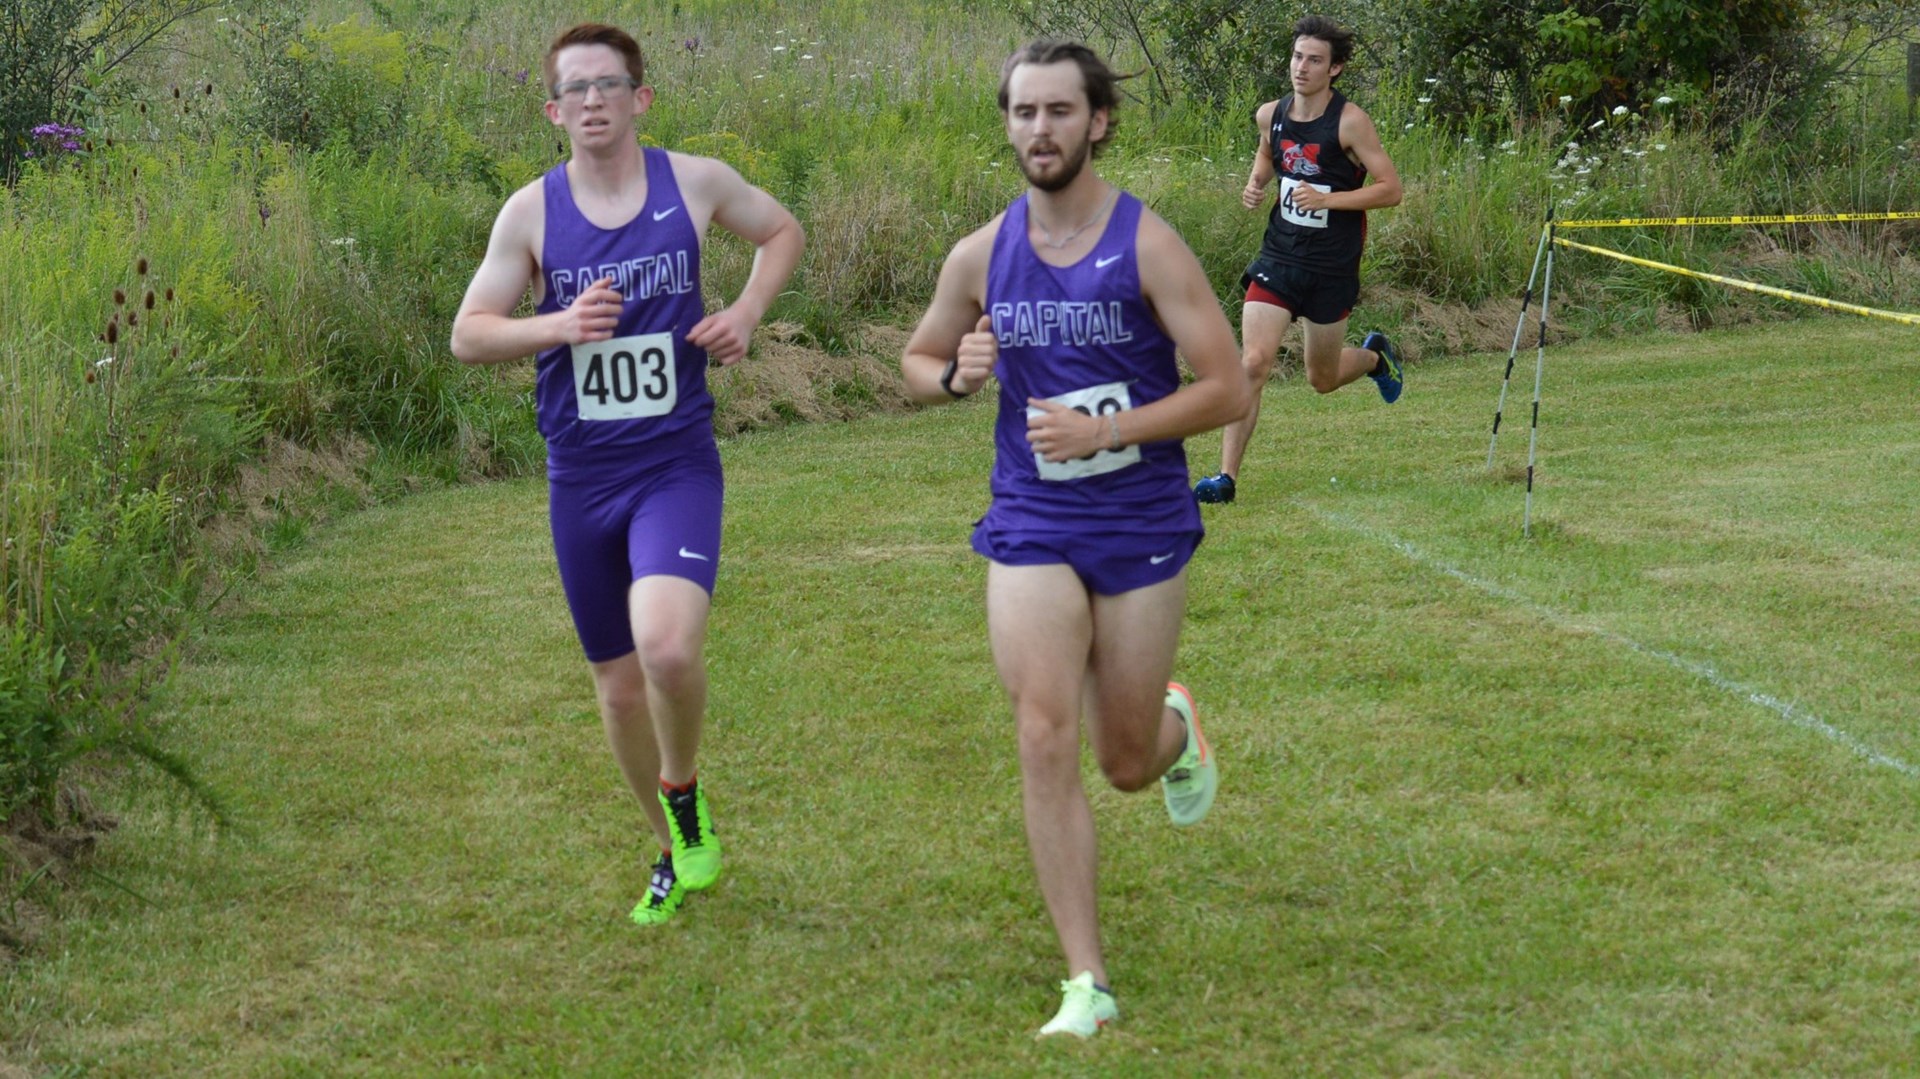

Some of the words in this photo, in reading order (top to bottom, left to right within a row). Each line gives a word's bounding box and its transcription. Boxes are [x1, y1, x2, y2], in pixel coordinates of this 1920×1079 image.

[551, 250, 693, 309] CAPITAL
[991, 301, 1133, 348] CAPITAL
[582, 347, 669, 405] 403
